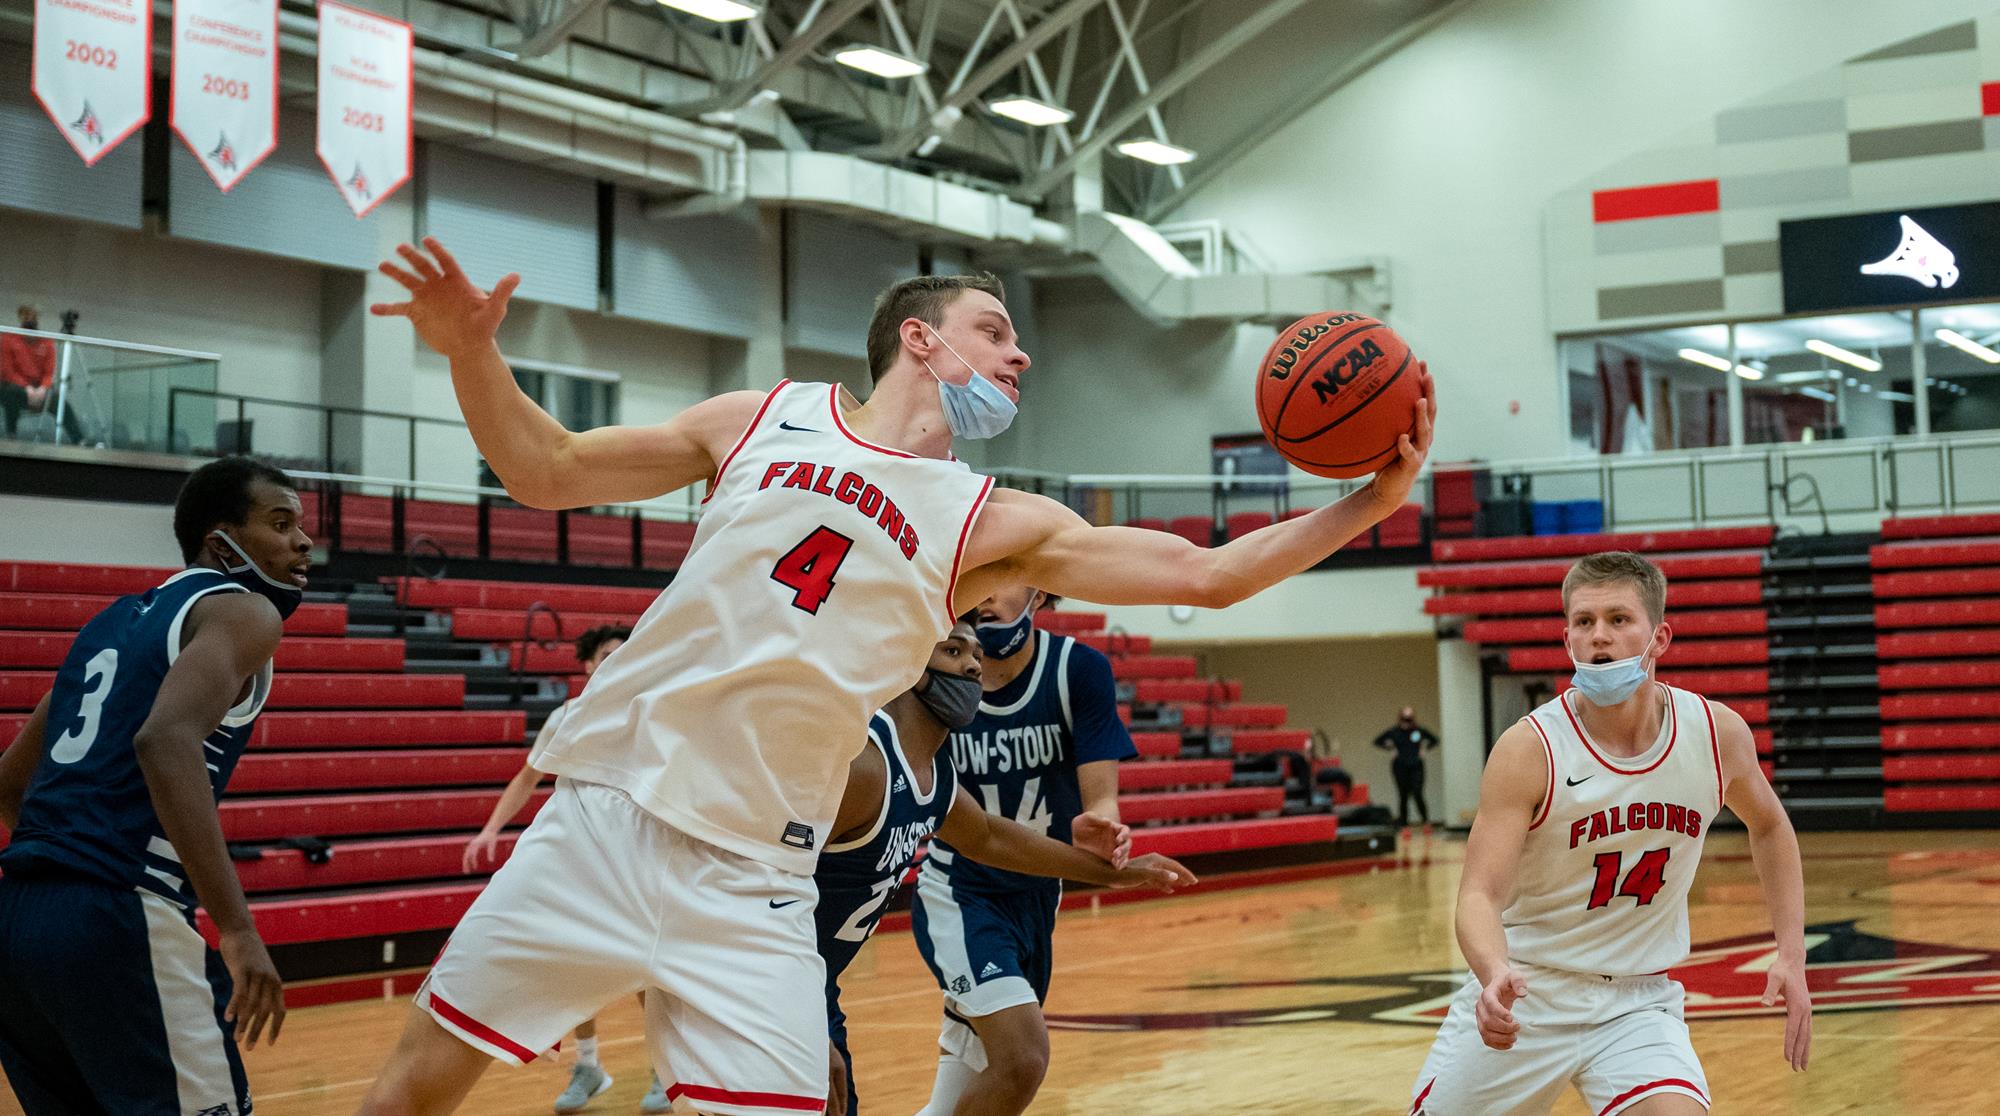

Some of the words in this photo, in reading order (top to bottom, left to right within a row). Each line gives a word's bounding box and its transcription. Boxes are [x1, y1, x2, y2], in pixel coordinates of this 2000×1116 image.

[65, 39, 118, 71] 2002
[203, 73, 250, 101] 2003
[342, 106, 385, 133] 2003
[1270, 312, 1368, 381] Wilson
[1311, 338, 1385, 405] NCAA
[758, 461, 920, 561] FALCONS
[770, 524, 854, 616] 4
[50, 648, 118, 764] 3
[950, 724, 1064, 775] UW-STOUT
[1569, 802, 1702, 850] FALCONS
[834, 866, 910, 942] 2
[1586, 847, 1670, 910] 14
